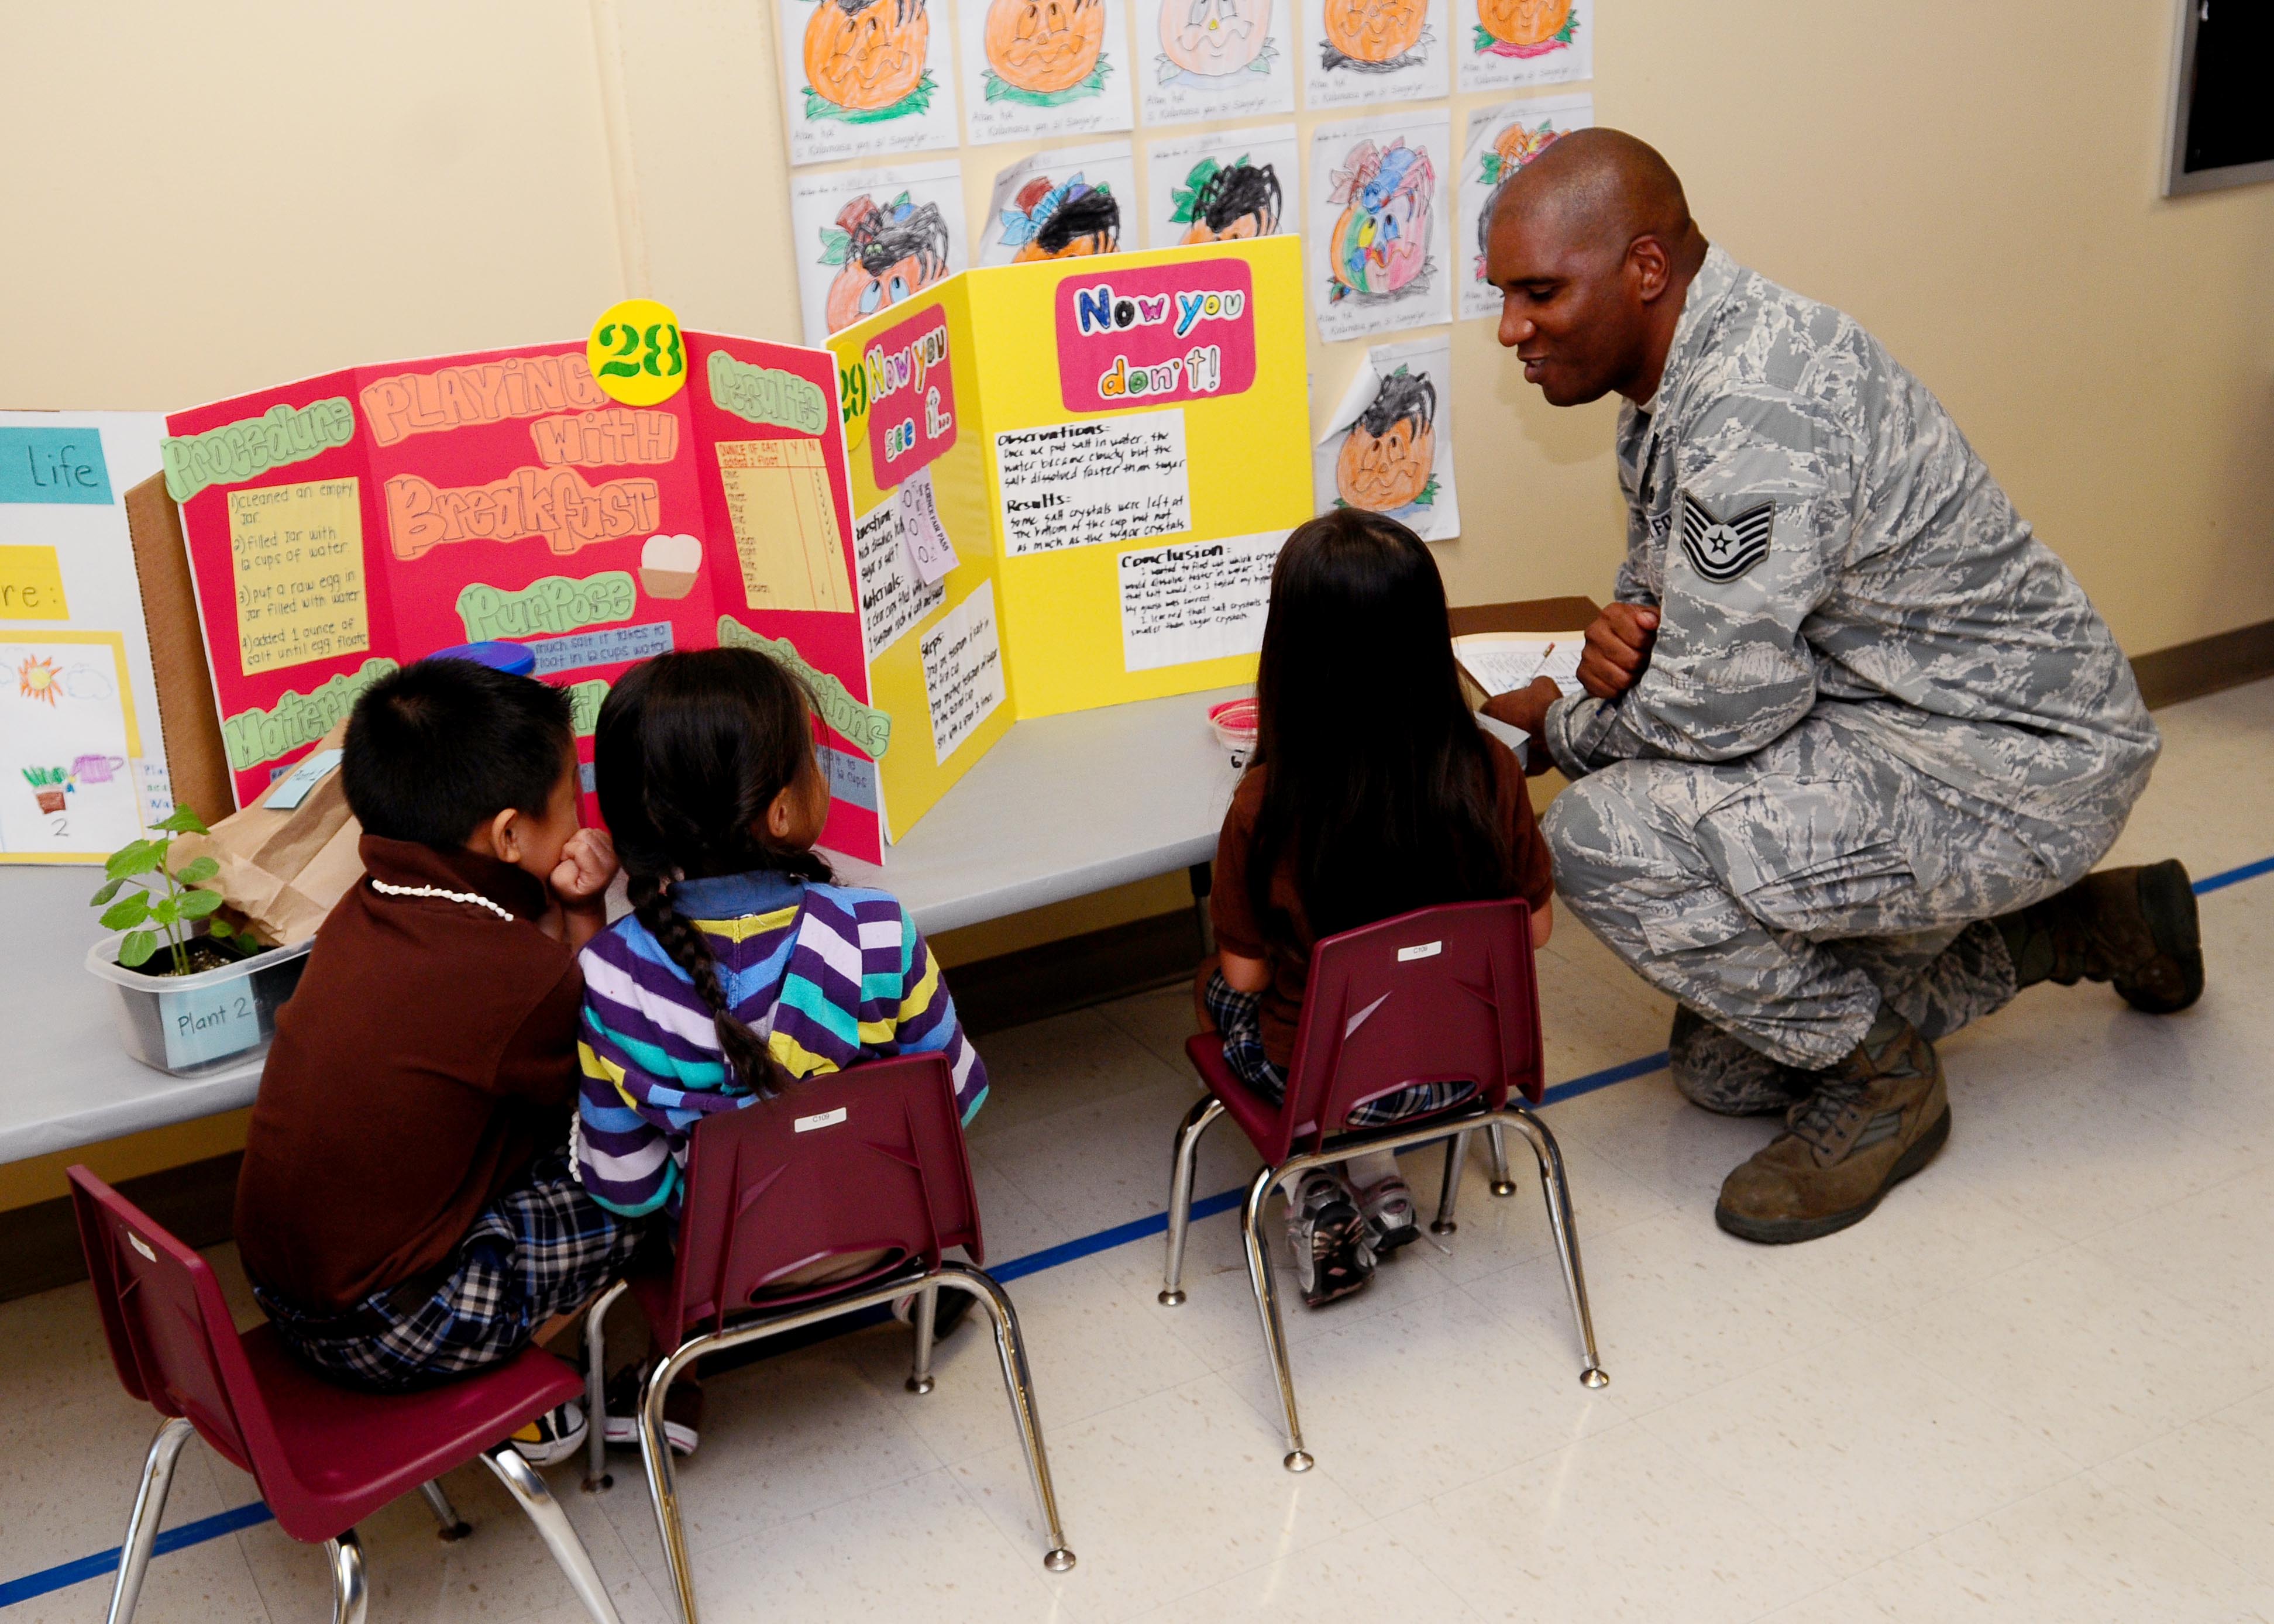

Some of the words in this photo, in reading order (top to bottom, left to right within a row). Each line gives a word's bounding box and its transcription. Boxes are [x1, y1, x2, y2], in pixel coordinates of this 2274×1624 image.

[1079, 287, 1164, 332] Now
[1175, 294, 1241, 336] you
[598, 324, 683, 377] 28
[867, 348, 910, 401] Now
[1102, 347, 1216, 397] don't!
[161, 402, 352, 499] Procedure
[1030, 446, 1043, 455] we
[1050, 441, 1066, 455] put
[1071, 437, 1091, 449] salt
[1095, 438, 1106, 447] in
[1150, 431, 1169, 441] the
[28, 445, 98, 488] Life
[1003, 460, 1037, 473] water
[1088, 448, 1124, 467] cloudy
[1153, 444, 1171, 455] the
[1004, 474, 1026, 488] salt
[1030, 466, 1078, 484] dissolved
[1083, 463, 1120, 479] faster
[1123, 463, 1150, 473] than
[295, 486, 312, 498] an
[319, 481, 353, 498] empty
[1044, 510, 1063, 524] salt
[1069, 503, 1112, 523] crystals
[1117, 501, 1140, 512] were
[1147, 494, 1168, 508] left
[1171, 495, 1183, 505] at
[1085, 519, 1105, 529] the
[1154, 507, 1172, 521] not
[309, 526, 336, 541] with
[1033, 537, 1062, 549] much
[1083, 532, 1103, 543] the
[1144, 518, 1184, 535] crystals
[240, 558, 251, 571] 12
[254, 553, 281, 570] cups
[285, 547, 301, 562] of
[1121, 545, 1231, 568] Conclusion:
[253, 586, 272, 604] put
[276, 583, 285, 596] a
[290, 580, 314, 594] raw
[319, 573, 340, 593] egg
[345, 567, 355, 582] in
[267, 598, 297, 616] filled
[301, 594, 326, 608] with
[331, 590, 360, 604] water
[291, 627, 300, 641] 1
[302, 622, 336, 638] ounce
[341, 617, 354, 629] of
[247, 648, 271, 666] salt
[277, 641, 307, 659] until
[311, 638, 331, 656] egg
[534, 654, 565, 669] loat
[569, 653, 583, 665] in
[599, 645, 629, 662] cups
[535, 639, 566, 654] much
[570, 635, 593, 649] salt
[51, 818, 69, 837] 2
[178, 1004, 225, 1036] Plant
[235, 997, 252, 1018] 2
